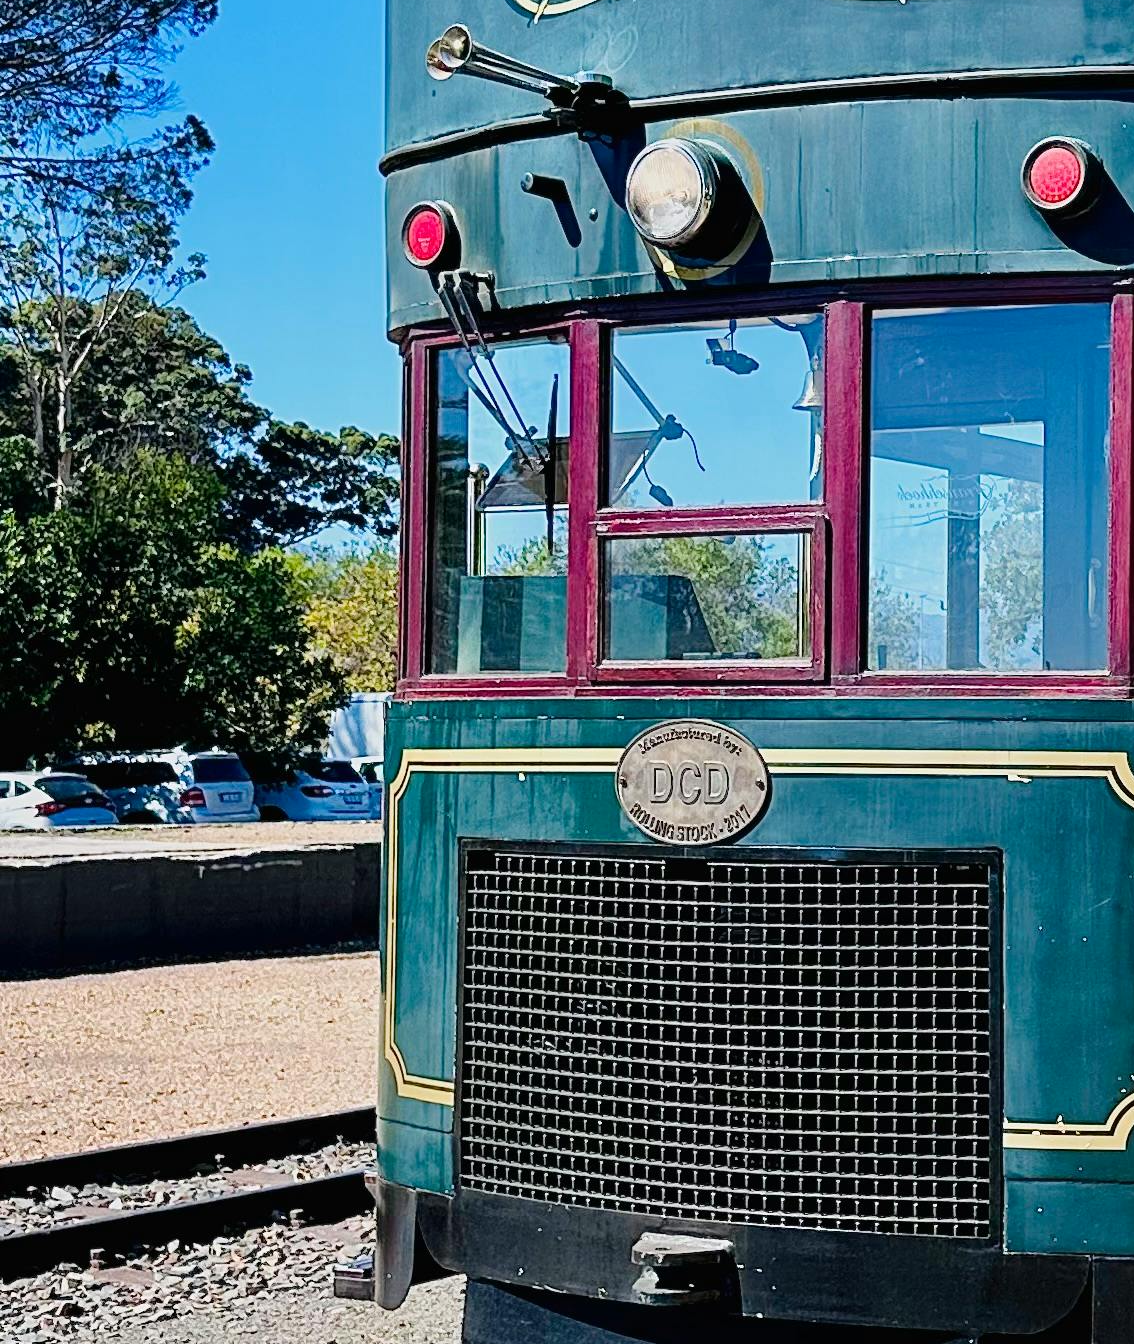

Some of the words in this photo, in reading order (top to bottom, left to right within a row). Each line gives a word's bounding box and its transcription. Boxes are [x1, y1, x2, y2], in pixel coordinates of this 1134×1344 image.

[648, 760, 730, 805] DCD
[630, 803, 675, 839] ROLLING
[677, 823, 717, 842] STOCK
[724, 804, 751, 833] 2017
